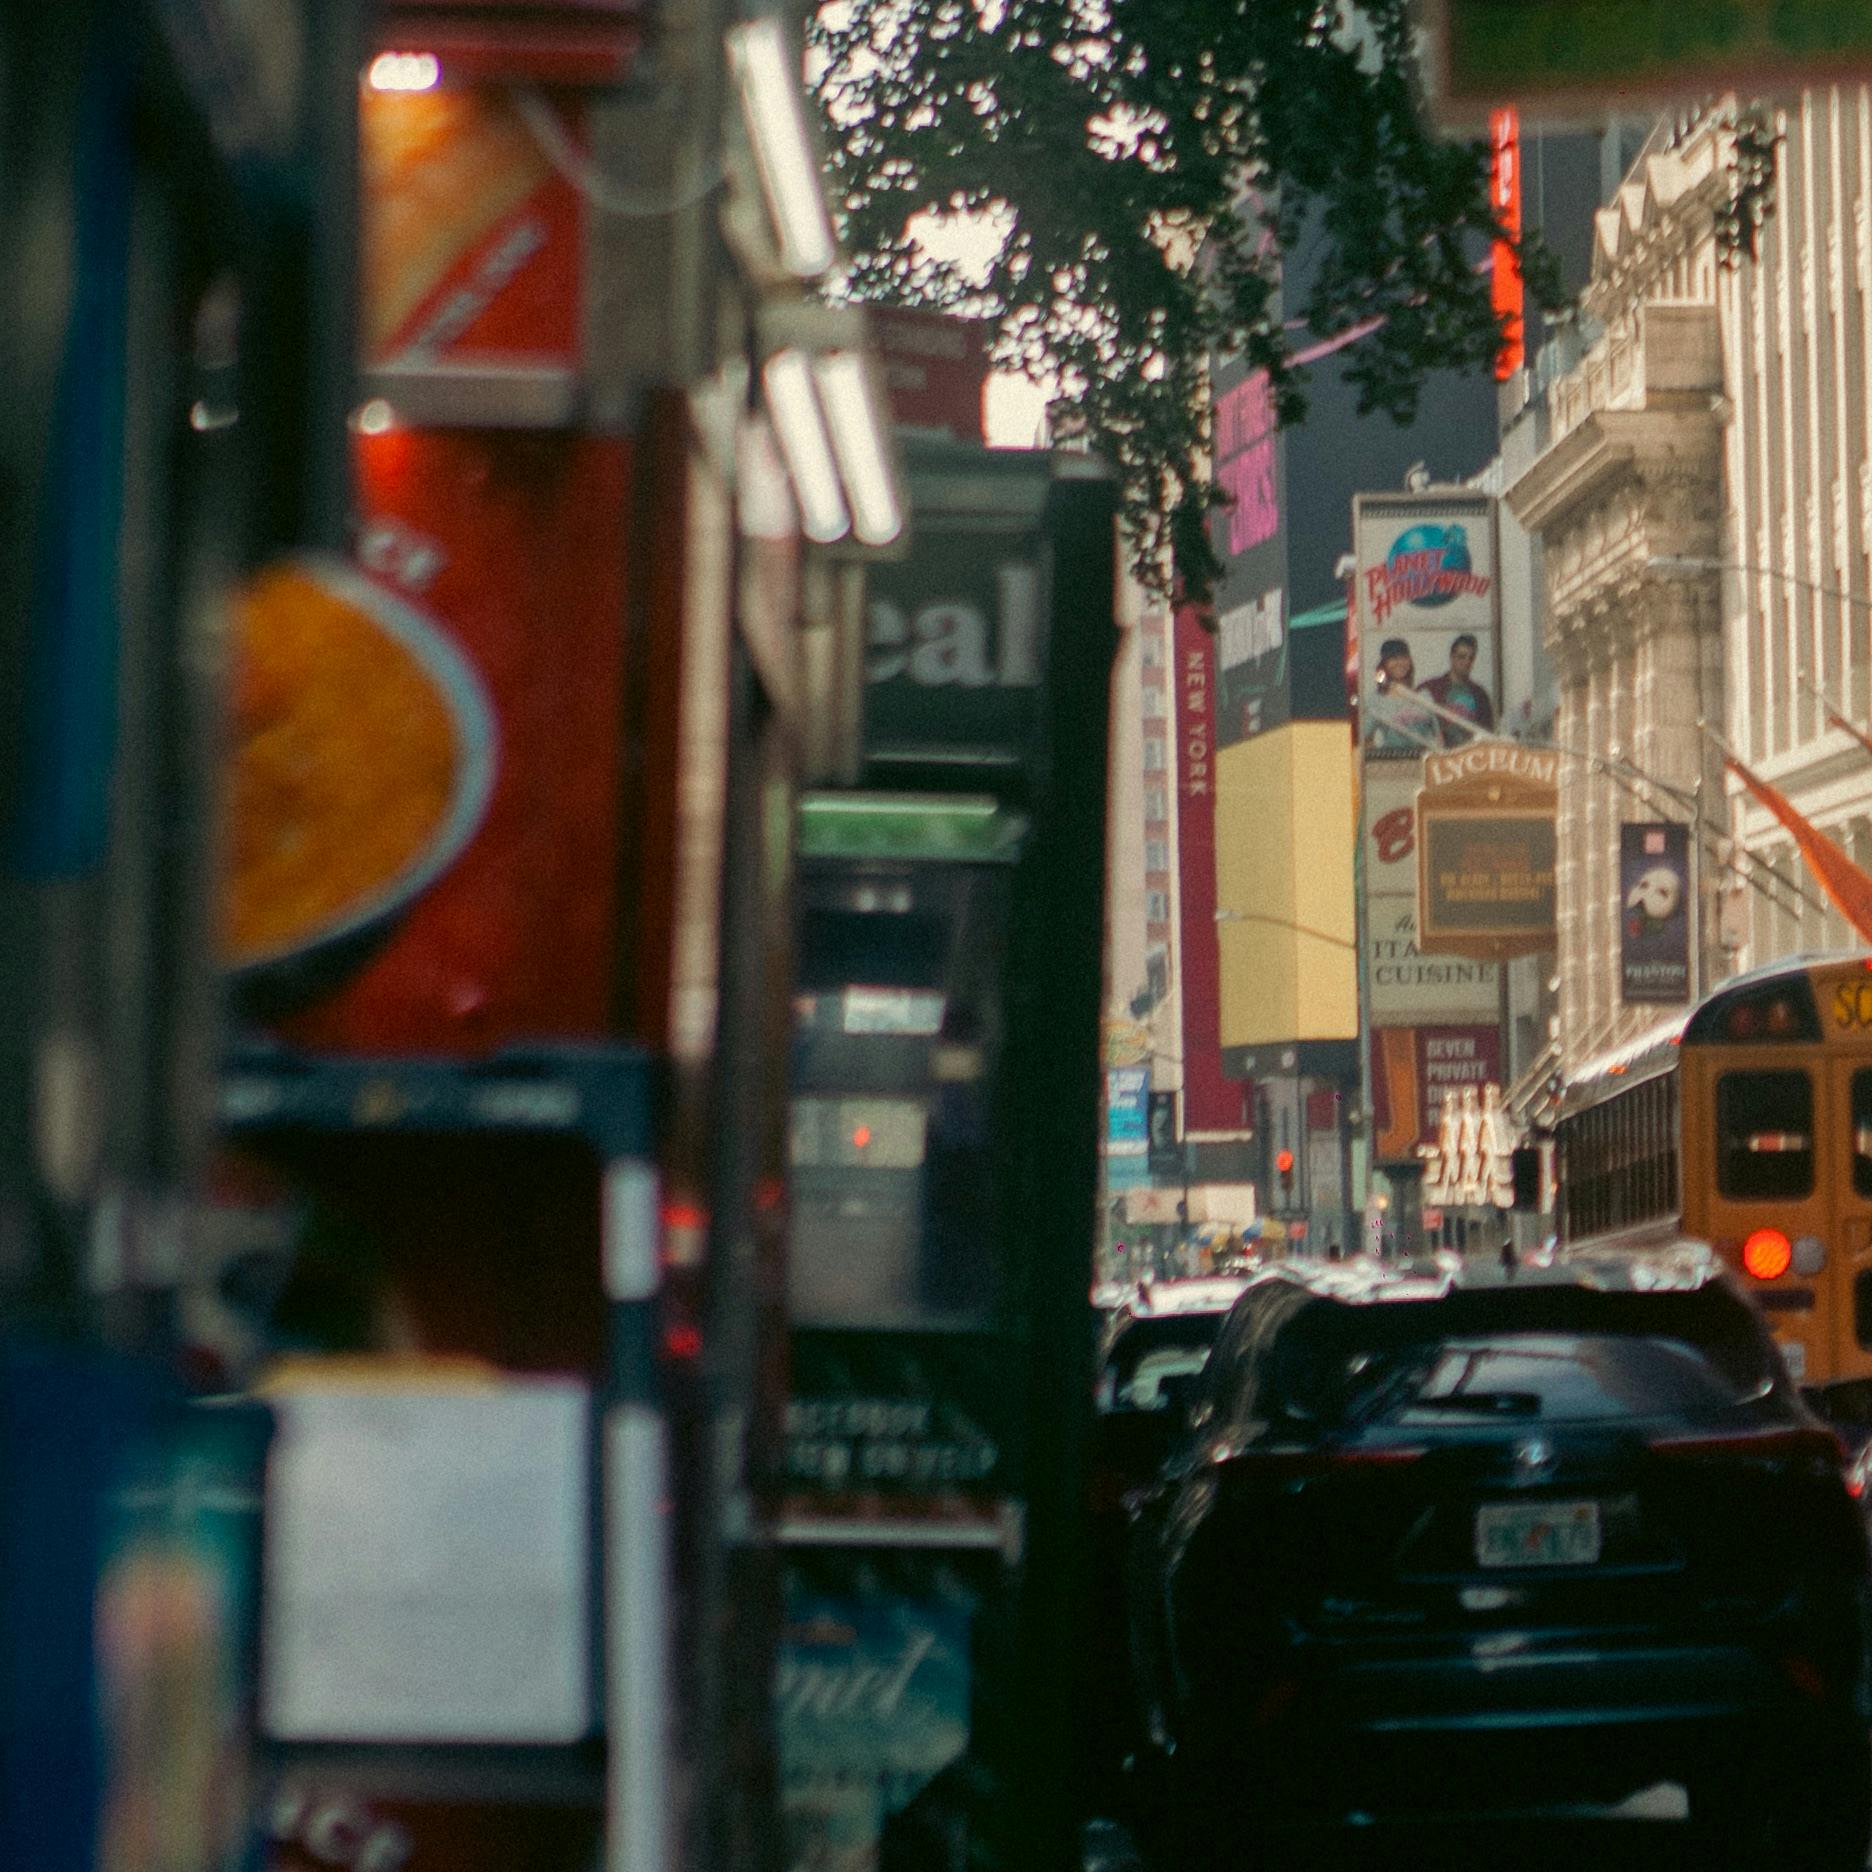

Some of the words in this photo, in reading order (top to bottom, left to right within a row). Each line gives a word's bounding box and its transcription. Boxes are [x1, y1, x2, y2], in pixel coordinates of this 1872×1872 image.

[1186, 651, 1206, 714] NEW
[1188, 723, 1209, 798] YORK
[1431, 747, 1555, 786] LYCEUM
[1373, 940, 1420, 960] ITA
[1376, 964, 1495, 986] CUISINE
